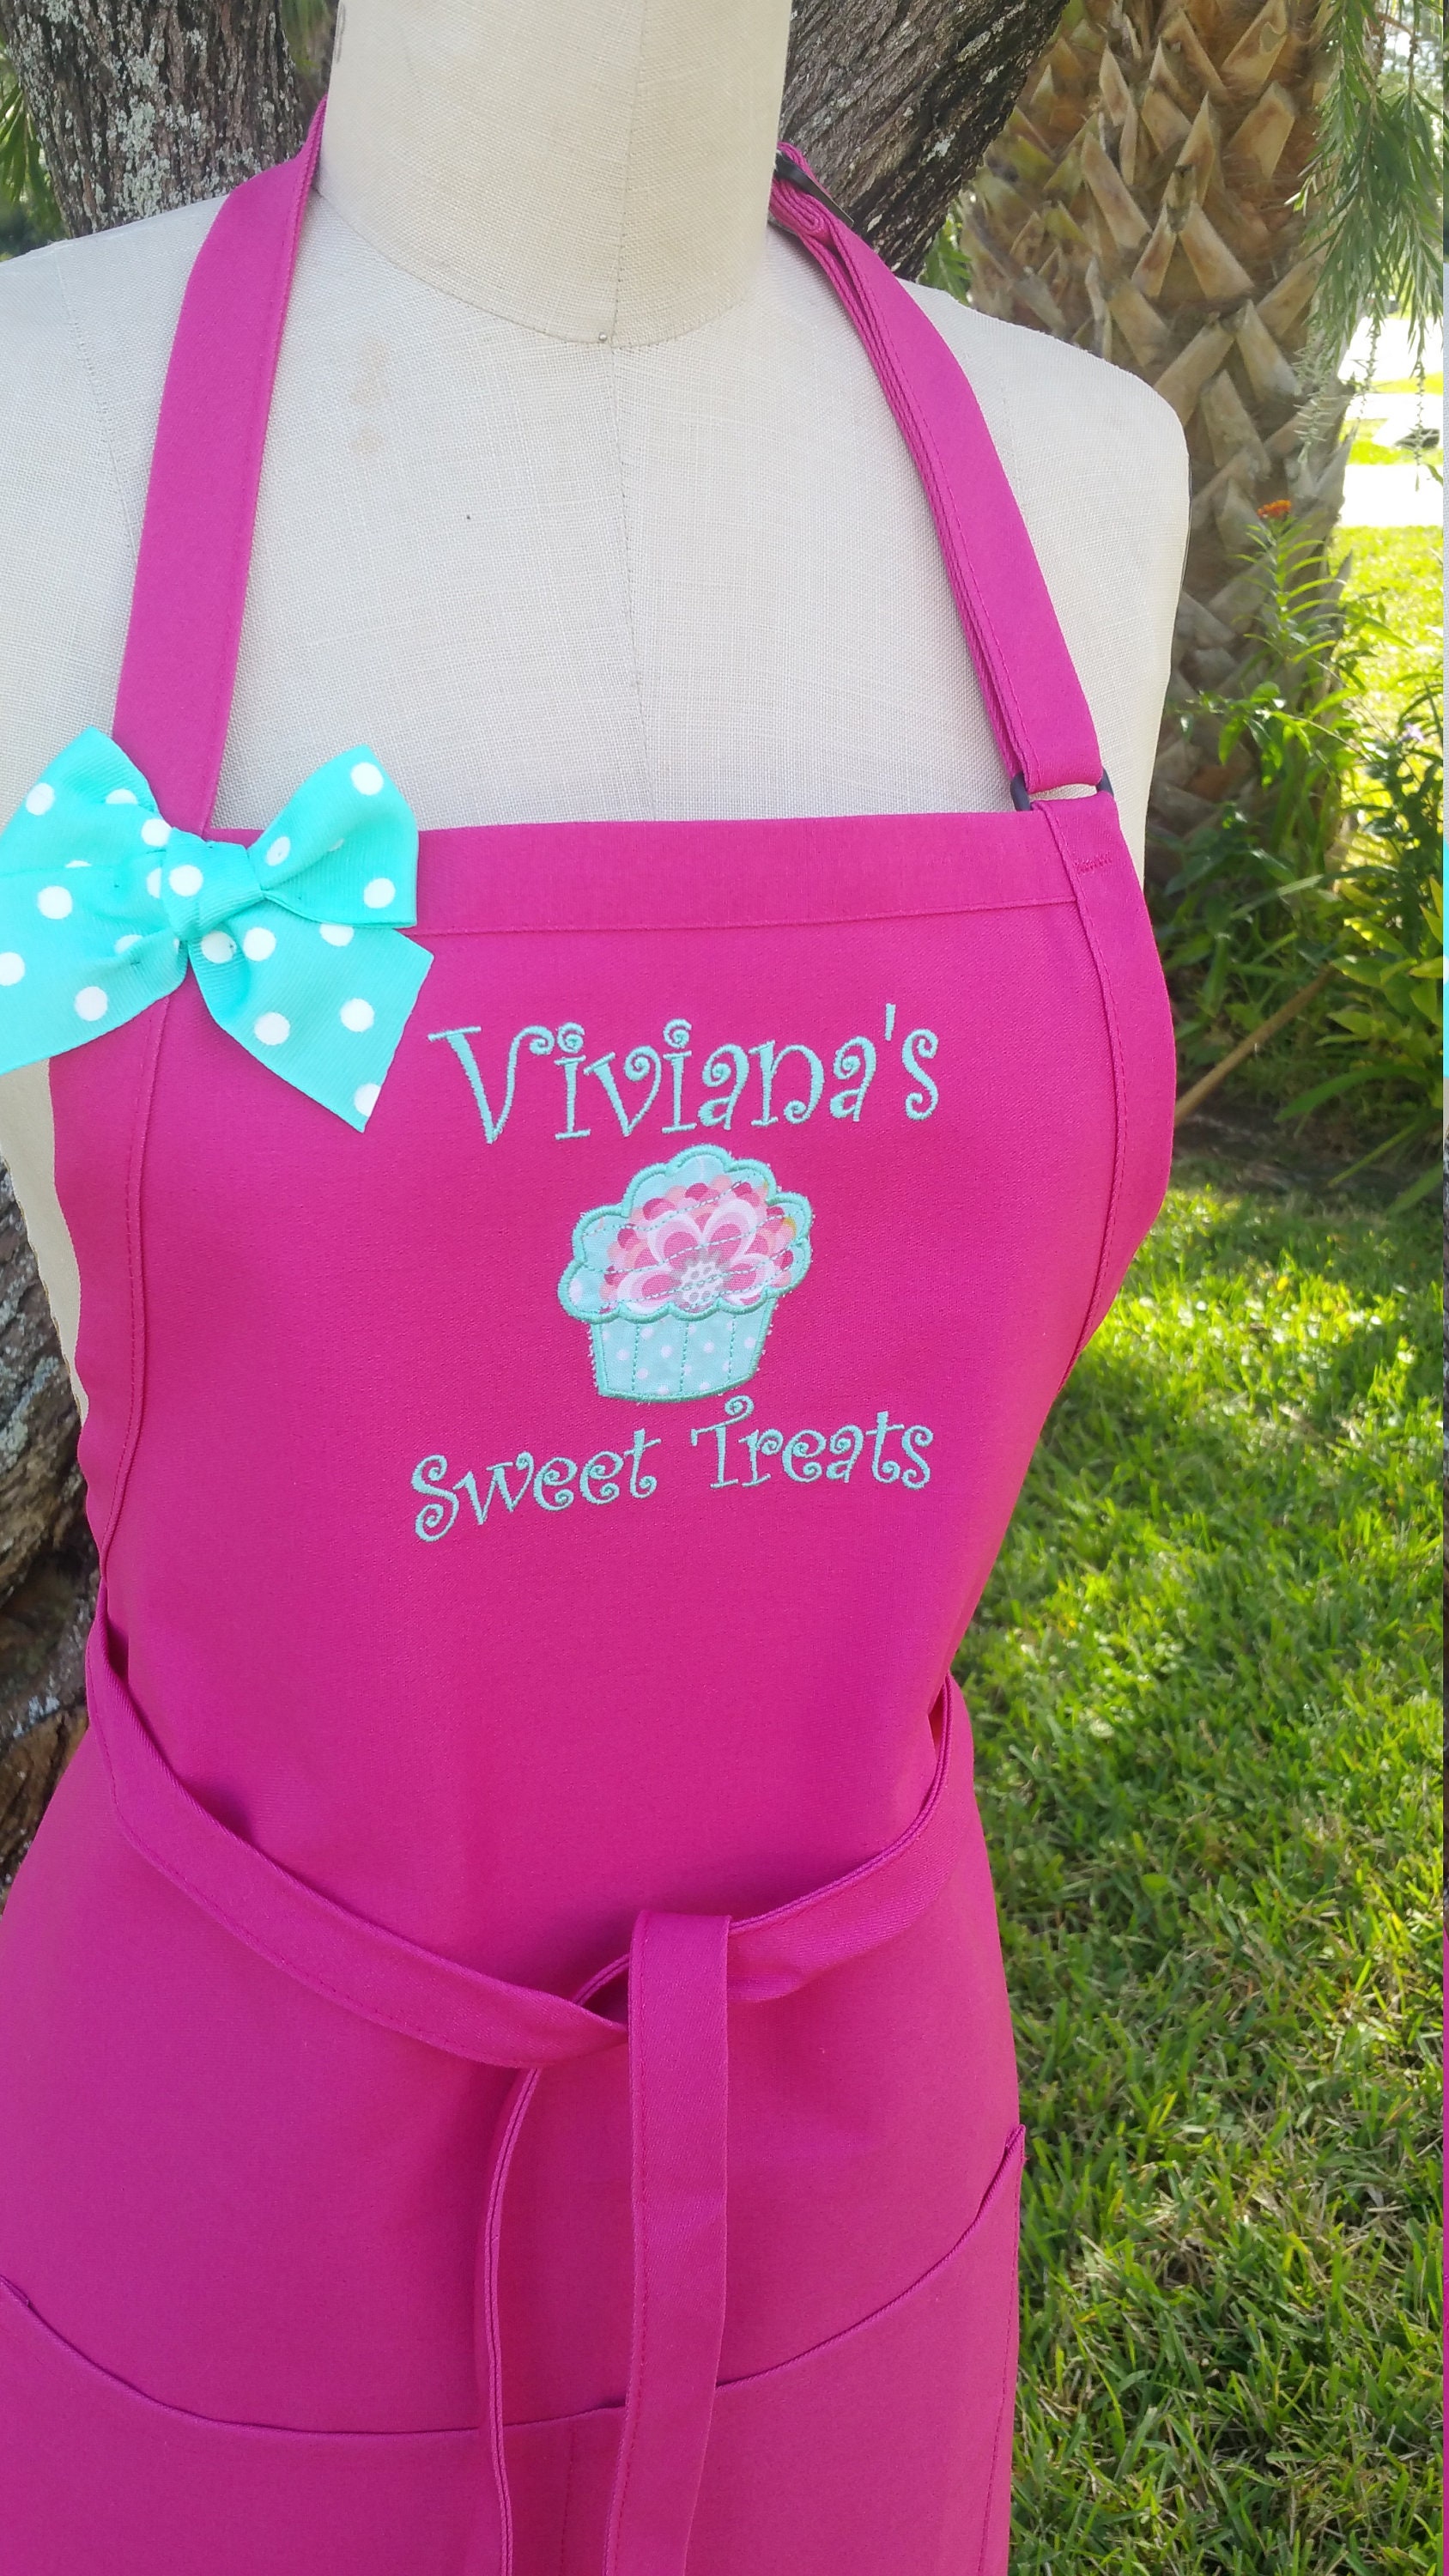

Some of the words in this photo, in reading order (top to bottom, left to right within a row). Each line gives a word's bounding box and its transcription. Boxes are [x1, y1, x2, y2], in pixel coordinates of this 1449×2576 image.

[427, 1002, 940, 1145] Viviana's
[410, 1427, 662, 1543] Sweet
[690, 1394, 935, 1491] Treats
